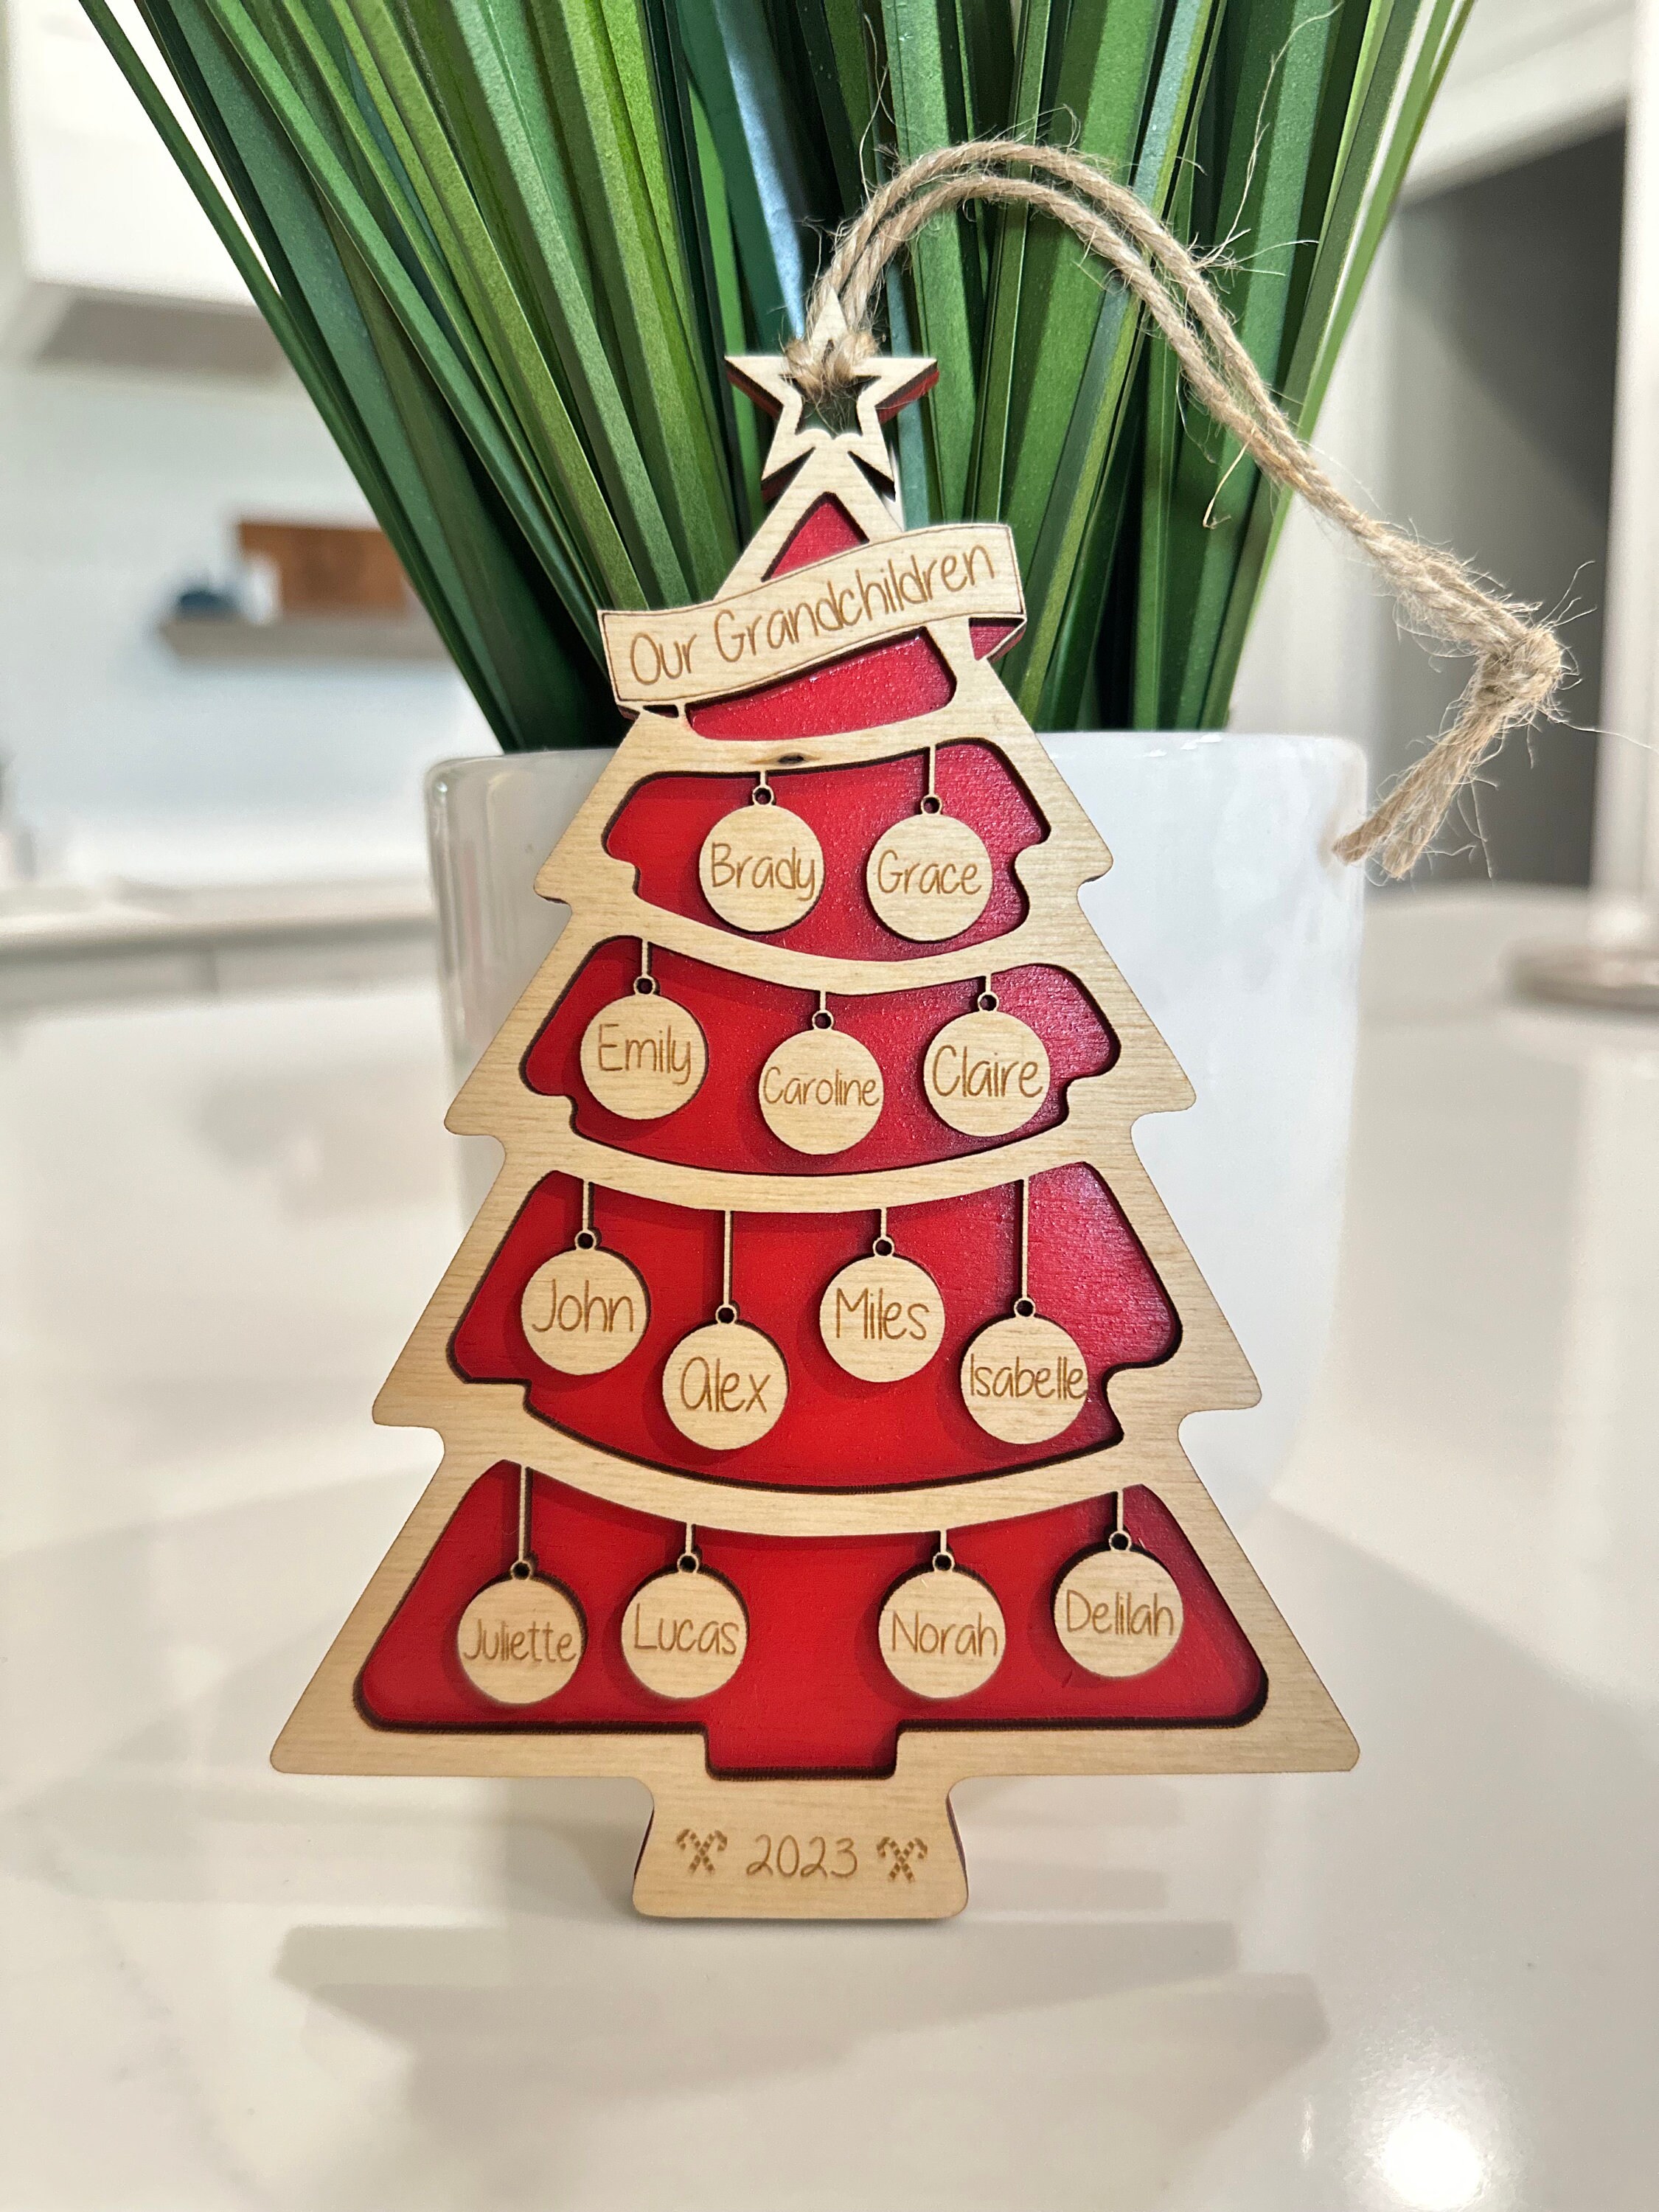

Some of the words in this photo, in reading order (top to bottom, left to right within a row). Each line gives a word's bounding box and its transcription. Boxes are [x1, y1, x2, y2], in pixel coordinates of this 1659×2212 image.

[630, 632, 697, 685] Our
[714, 544, 995, 662] Grandchildren
[711, 842, 815, 902] Brady
[877, 849, 982, 894] Grace
[597, 1023, 692, 1085] Emily
[932, 1044, 1043, 1099] Claire
[762, 1066, 880, 1107] Caroline
[532, 1279, 634, 1334] John
[835, 1287, 929, 1341] Miles
[680, 1357, 770, 1413] Alex
[969, 1352, 1088, 1401] Isabelle
[633, 1603, 739, 1655] Lucas
[892, 1610, 998, 1657] Norah
[1067, 1590, 1173, 1637] Delilah
[463, 1618, 576, 1663] Juliette
[746, 1834, 858, 1879] 2023
